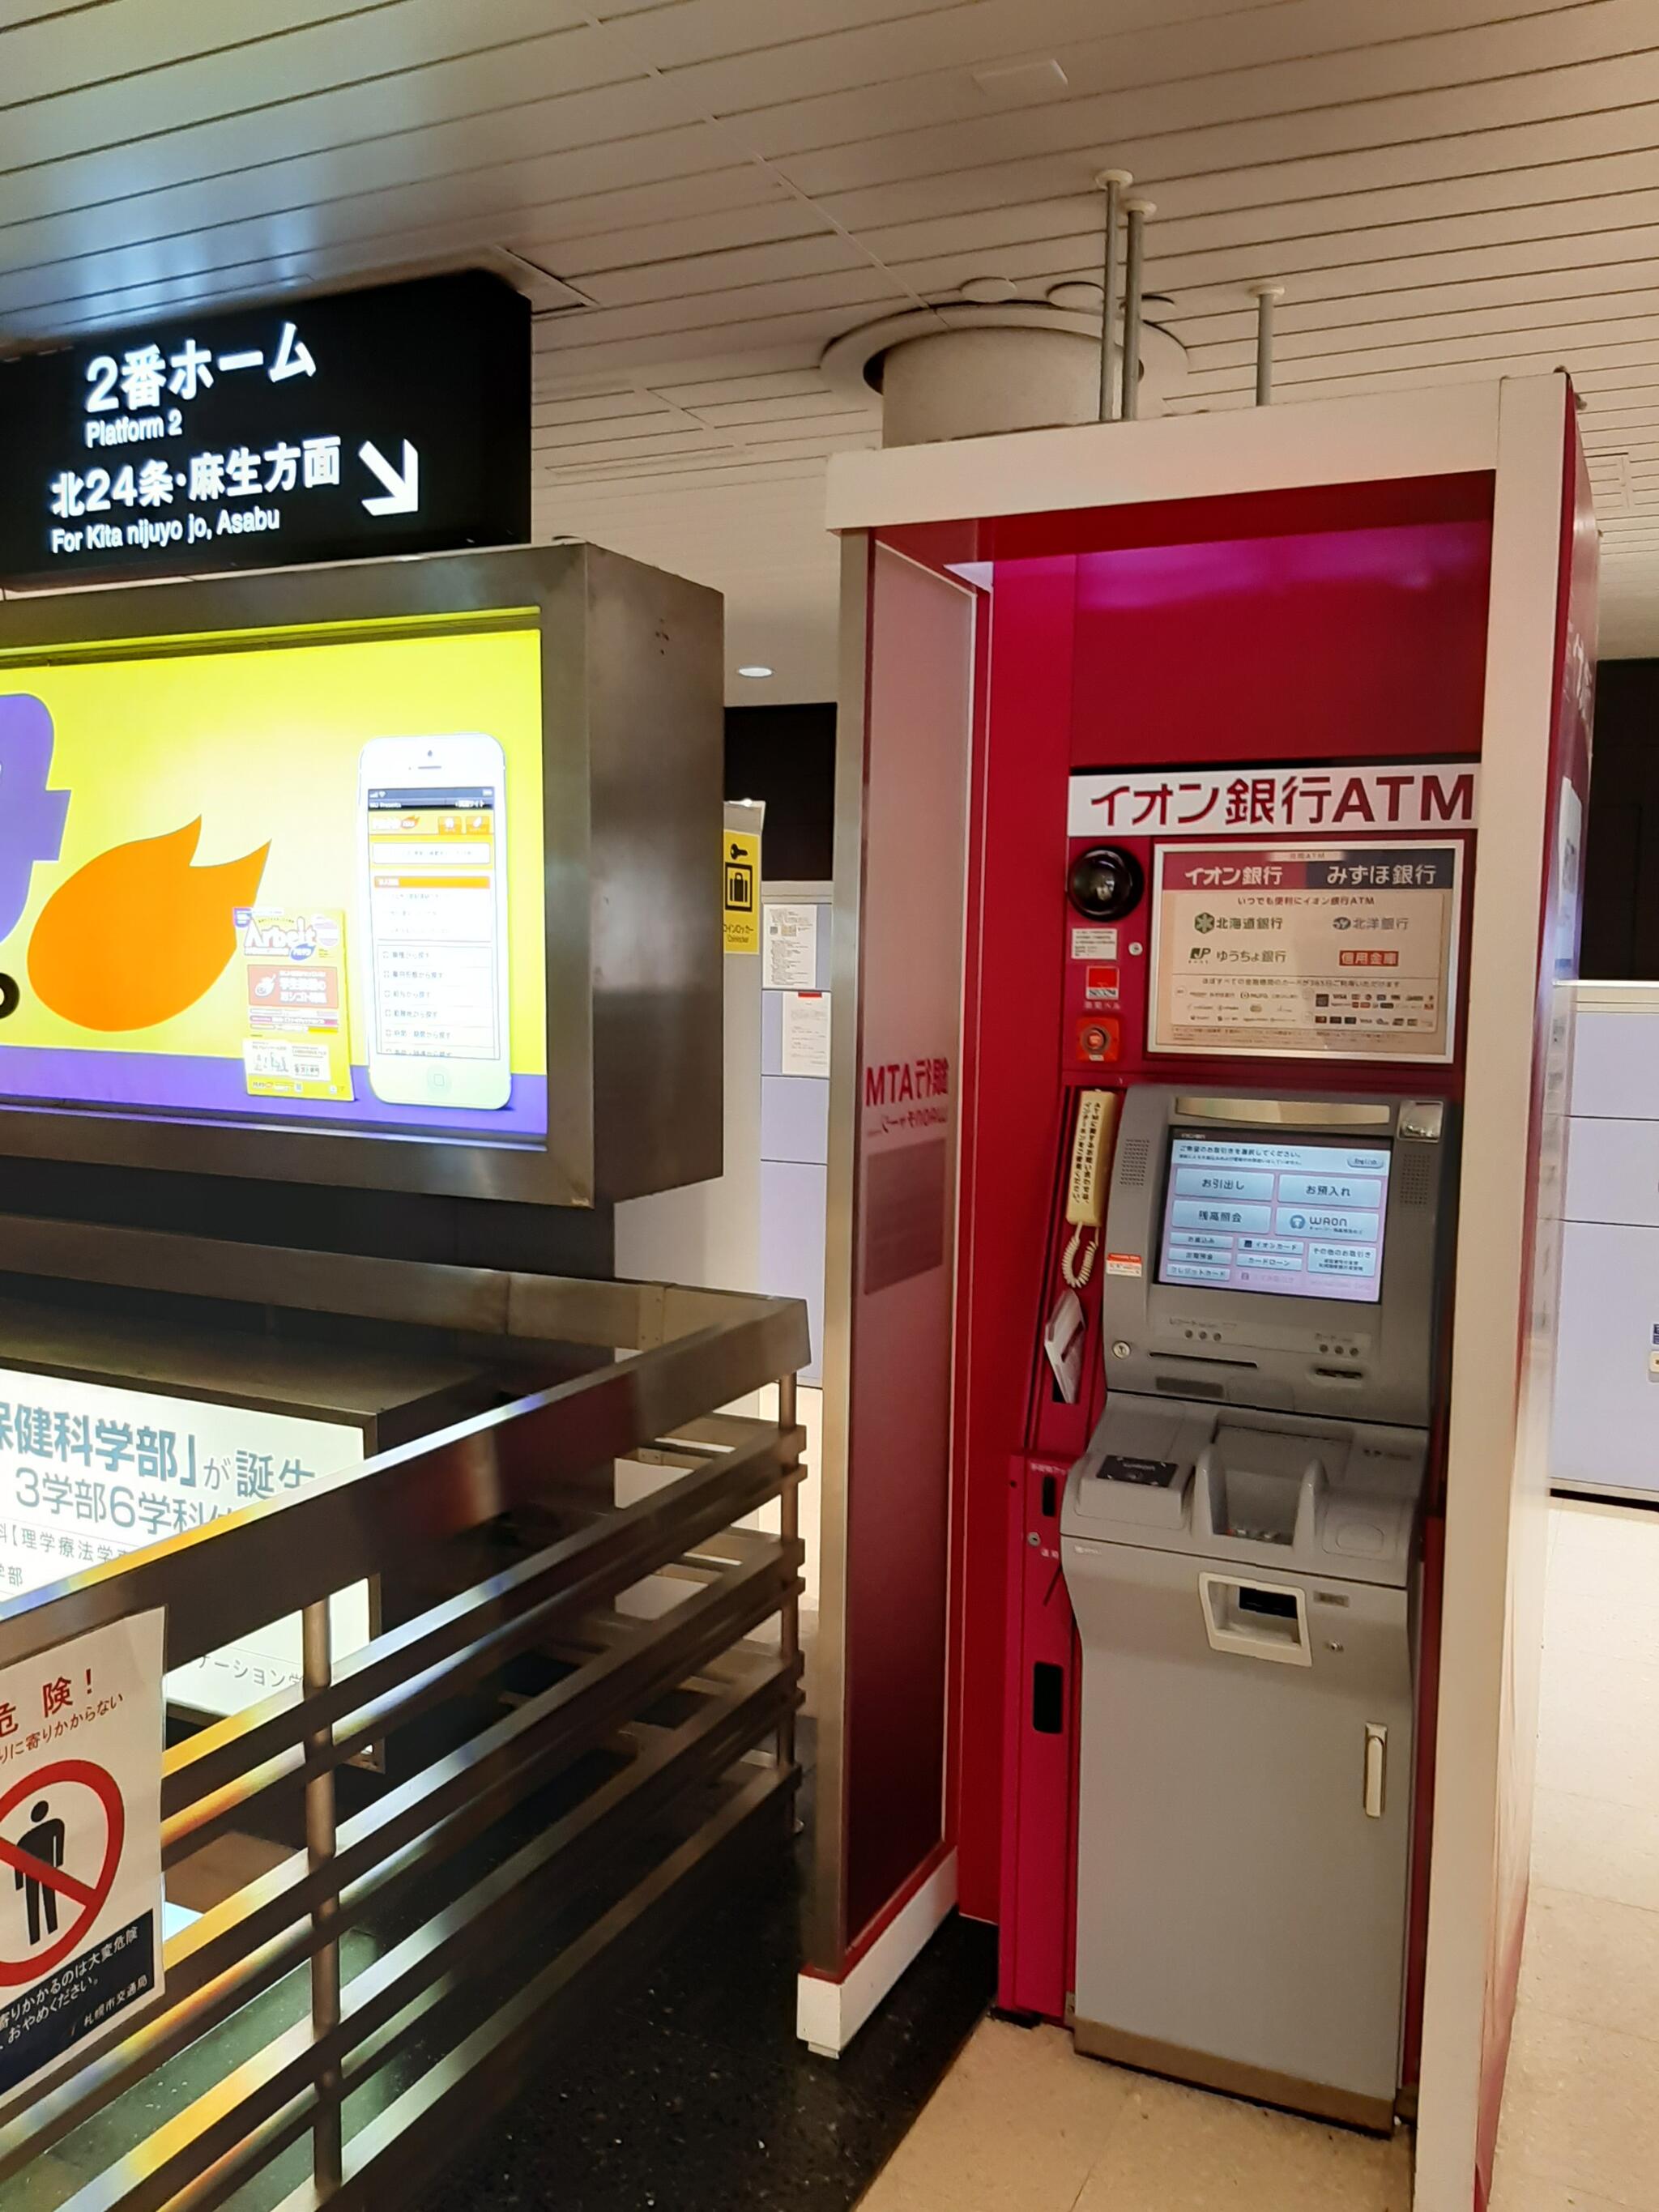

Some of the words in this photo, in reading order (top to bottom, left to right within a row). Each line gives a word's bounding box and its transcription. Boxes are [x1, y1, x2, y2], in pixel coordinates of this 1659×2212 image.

[85, 322, 317, 412] 2番ホーム
[86, 418, 164, 448] Platform
[168, 410, 182, 436] 2
[50, 435, 342, 518] 北24条・麻生方面
[52, 526, 83, 553] For
[87, 523, 122, 548] Kita
[127, 519, 183, 548] nijuyo
[187, 518, 212, 544] jo,
[216, 505, 280, 535] Asabu
[1090, 774, 1474, 826] イオン銀行ATM
[1184, 866, 1282, 885] イオン銀行
[1327, 864, 1437, 884] みずほ銀行
[1238, 896, 1375, 906] いつでも便利にイオン銀行ATM
[1216, 917, 1283, 931] 北海道銀行
[1353, 917, 1410, 931] 北洋銀行
[1217, 949, 1286, 962] ゆうちょ銀行
[1341, 951, 1397, 965] 信用金庫
[1202, 1178, 1245, 1190] お引出し
[1306, 1185, 1351, 1196] お預入れ
[1199, 1210, 1243, 1223] 残高照会
[1309, 1217, 1348, 1226] WAON
[1247, 1257, 1290, 1267] カードローン
[84, 1974, 148, 2027] 札幌市交通局
